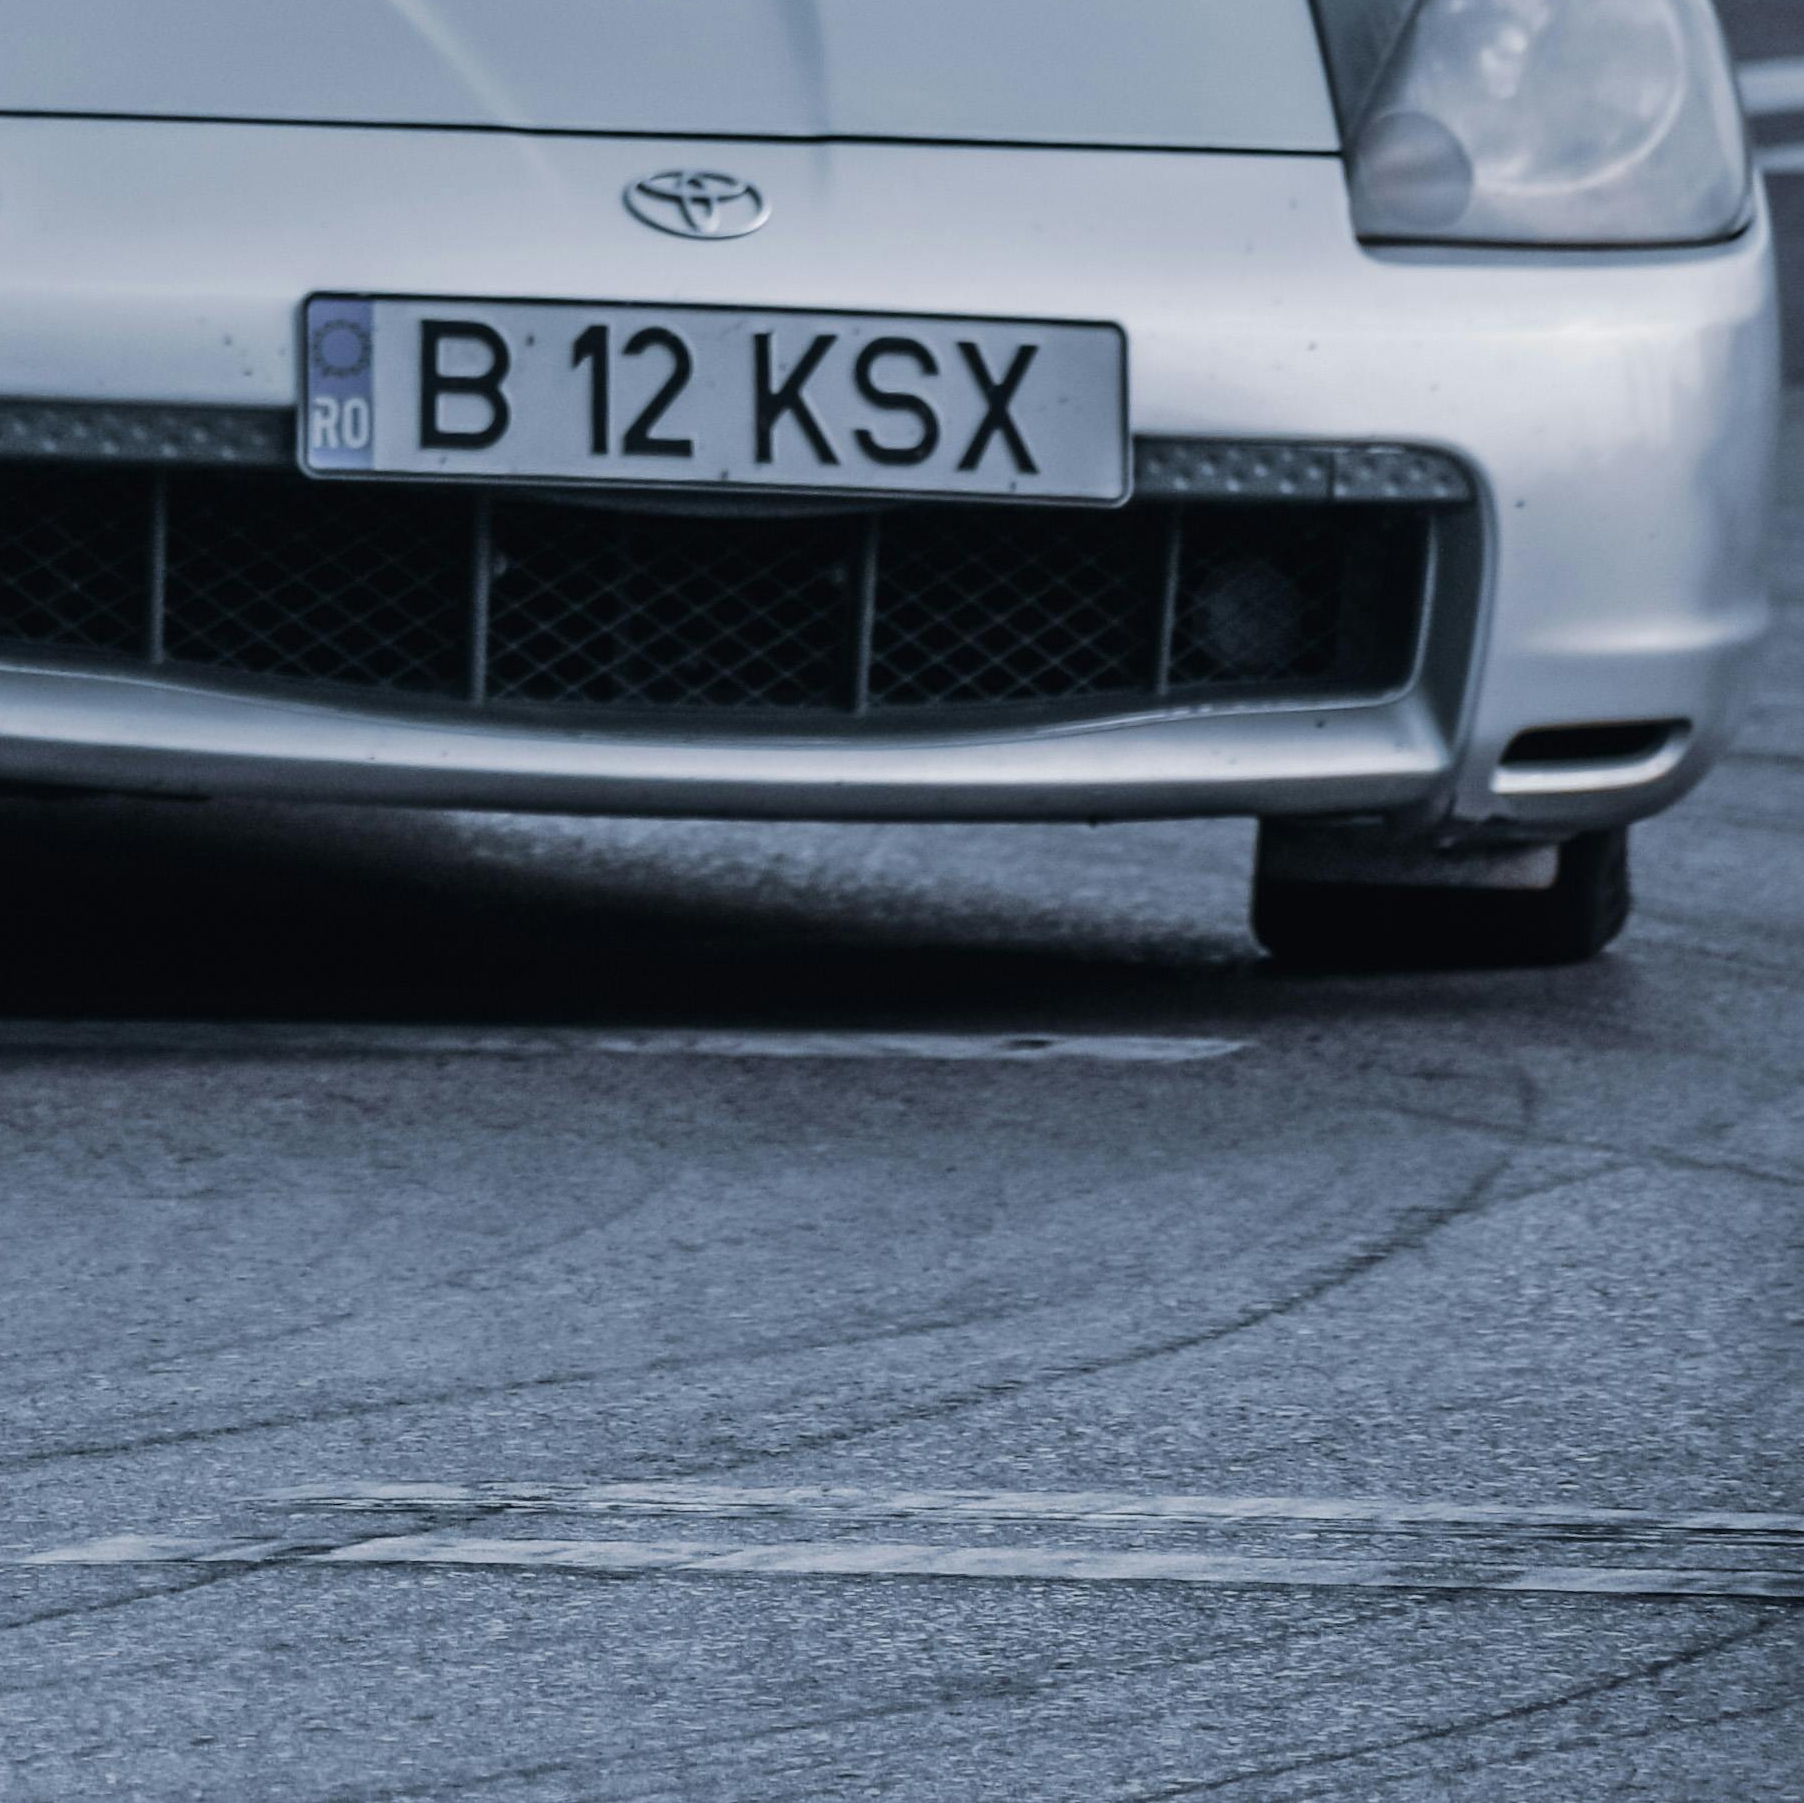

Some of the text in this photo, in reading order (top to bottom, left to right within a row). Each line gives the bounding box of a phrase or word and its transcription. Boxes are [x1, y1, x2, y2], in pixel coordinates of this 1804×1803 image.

[311, 396, 372, 450] RO
[419, 318, 1041, 474] B 12 KSX
